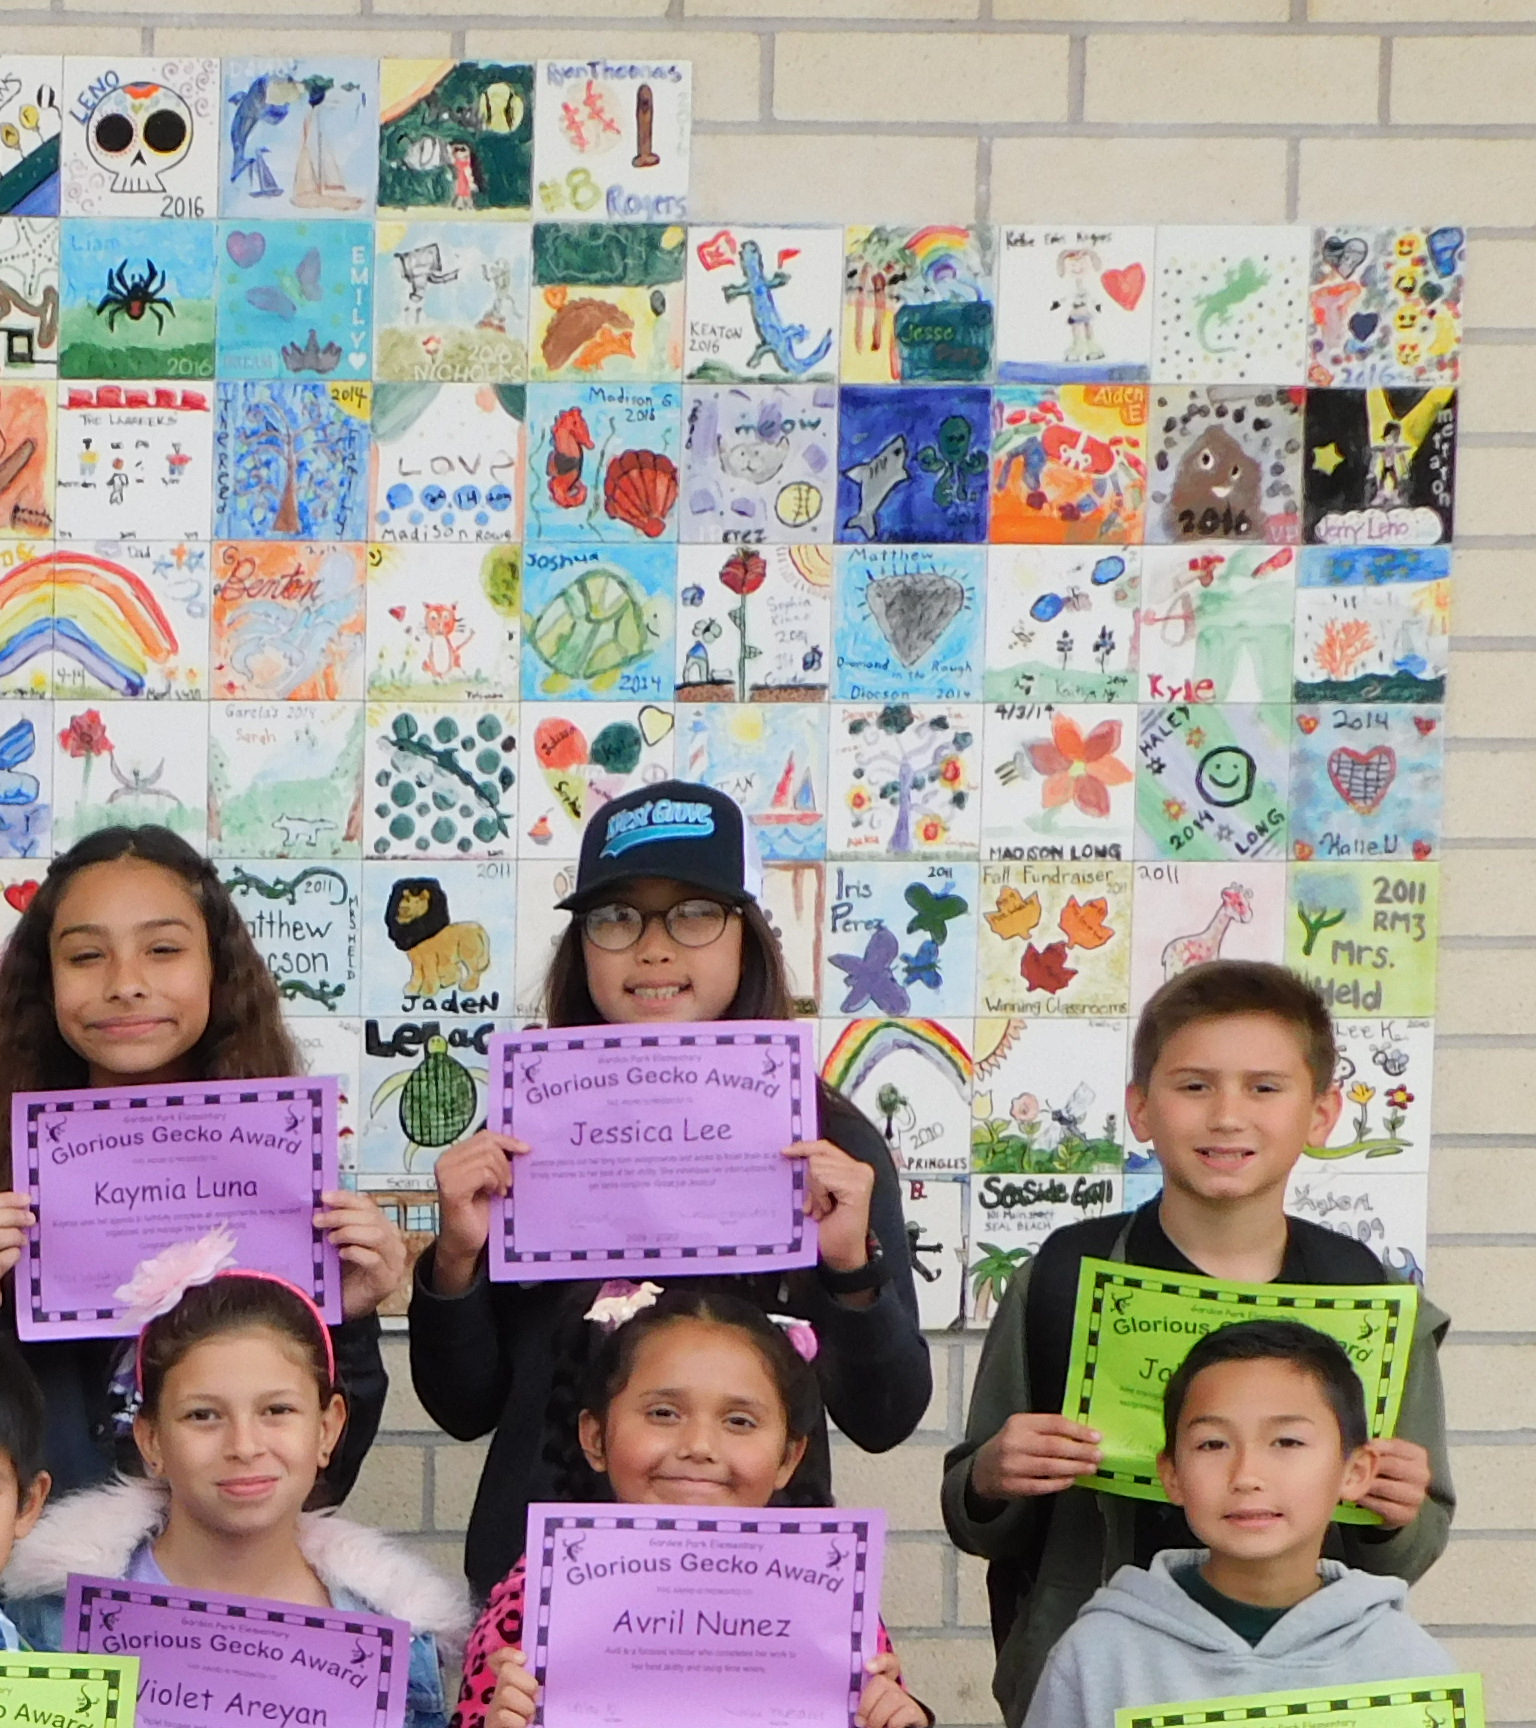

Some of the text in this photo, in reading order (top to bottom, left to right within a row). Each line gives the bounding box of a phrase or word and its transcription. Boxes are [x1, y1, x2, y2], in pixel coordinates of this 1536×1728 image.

[69, 70, 120, 125] LENO
[160, 196, 204, 218] 2016
[690, 321, 743, 339] KEATON
[527, 550, 599, 570] Joshua
[221, 558, 323, 600] Benton
[1139, 705, 1191, 757] HALEY
[1332, 710, 1389, 730] 2014
[1234, 808, 1286, 855] LONG
[837, 870, 873, 901] Iris
[983, 866, 1115, 884] Fall Fundraiser
[1373, 877, 1426, 905] 2011
[831, 905, 883, 934] Perez
[1373, 911, 1426, 941] RM3
[1331, 939, 1395, 970] Mrs.
[985, 997, 1128, 1016] Winning Classrooms
[526, 1066, 780, 1105] Glorious Gecko Award
[52, 1126, 302, 1164] Glorious Gecko Award
[571, 1119, 732, 1146] Jessica Lee
[907, 1157, 967, 1171] PRINGLES
[95, 1176, 257, 1210] Kaymia Luna
[1114, 1316, 1209, 1335] Glorious
[1337, 1340, 1373, 1362] ard
[567, 1553, 844, 1594] Glorious Gecko Award
[613, 1609, 791, 1637] Avril Nunez
[103, 1633, 368, 1689] Glorious Gecko Award
[226, 1693, 327, 1728] Areyan
